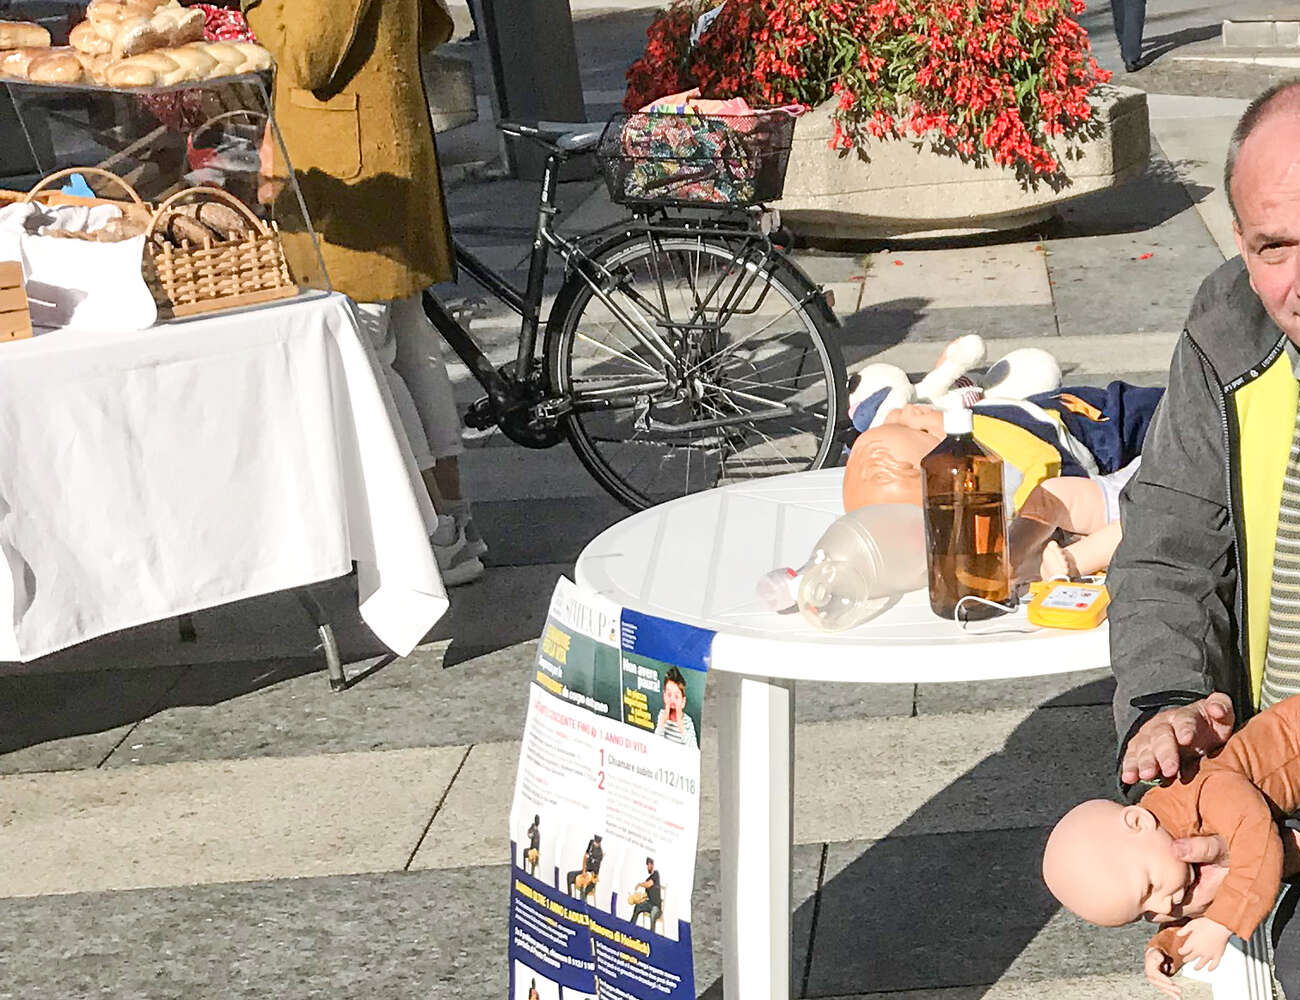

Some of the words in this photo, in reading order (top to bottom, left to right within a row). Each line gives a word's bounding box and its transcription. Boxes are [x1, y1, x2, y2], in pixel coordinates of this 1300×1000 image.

[605, 732, 624, 747] ANNO
[633, 741, 647, 753] VITA
[599, 748, 604, 767] 1
[598, 770, 605, 790] 2
[608, 754, 635, 772] Chiamare
[659, 768, 696, 794] 112/118
